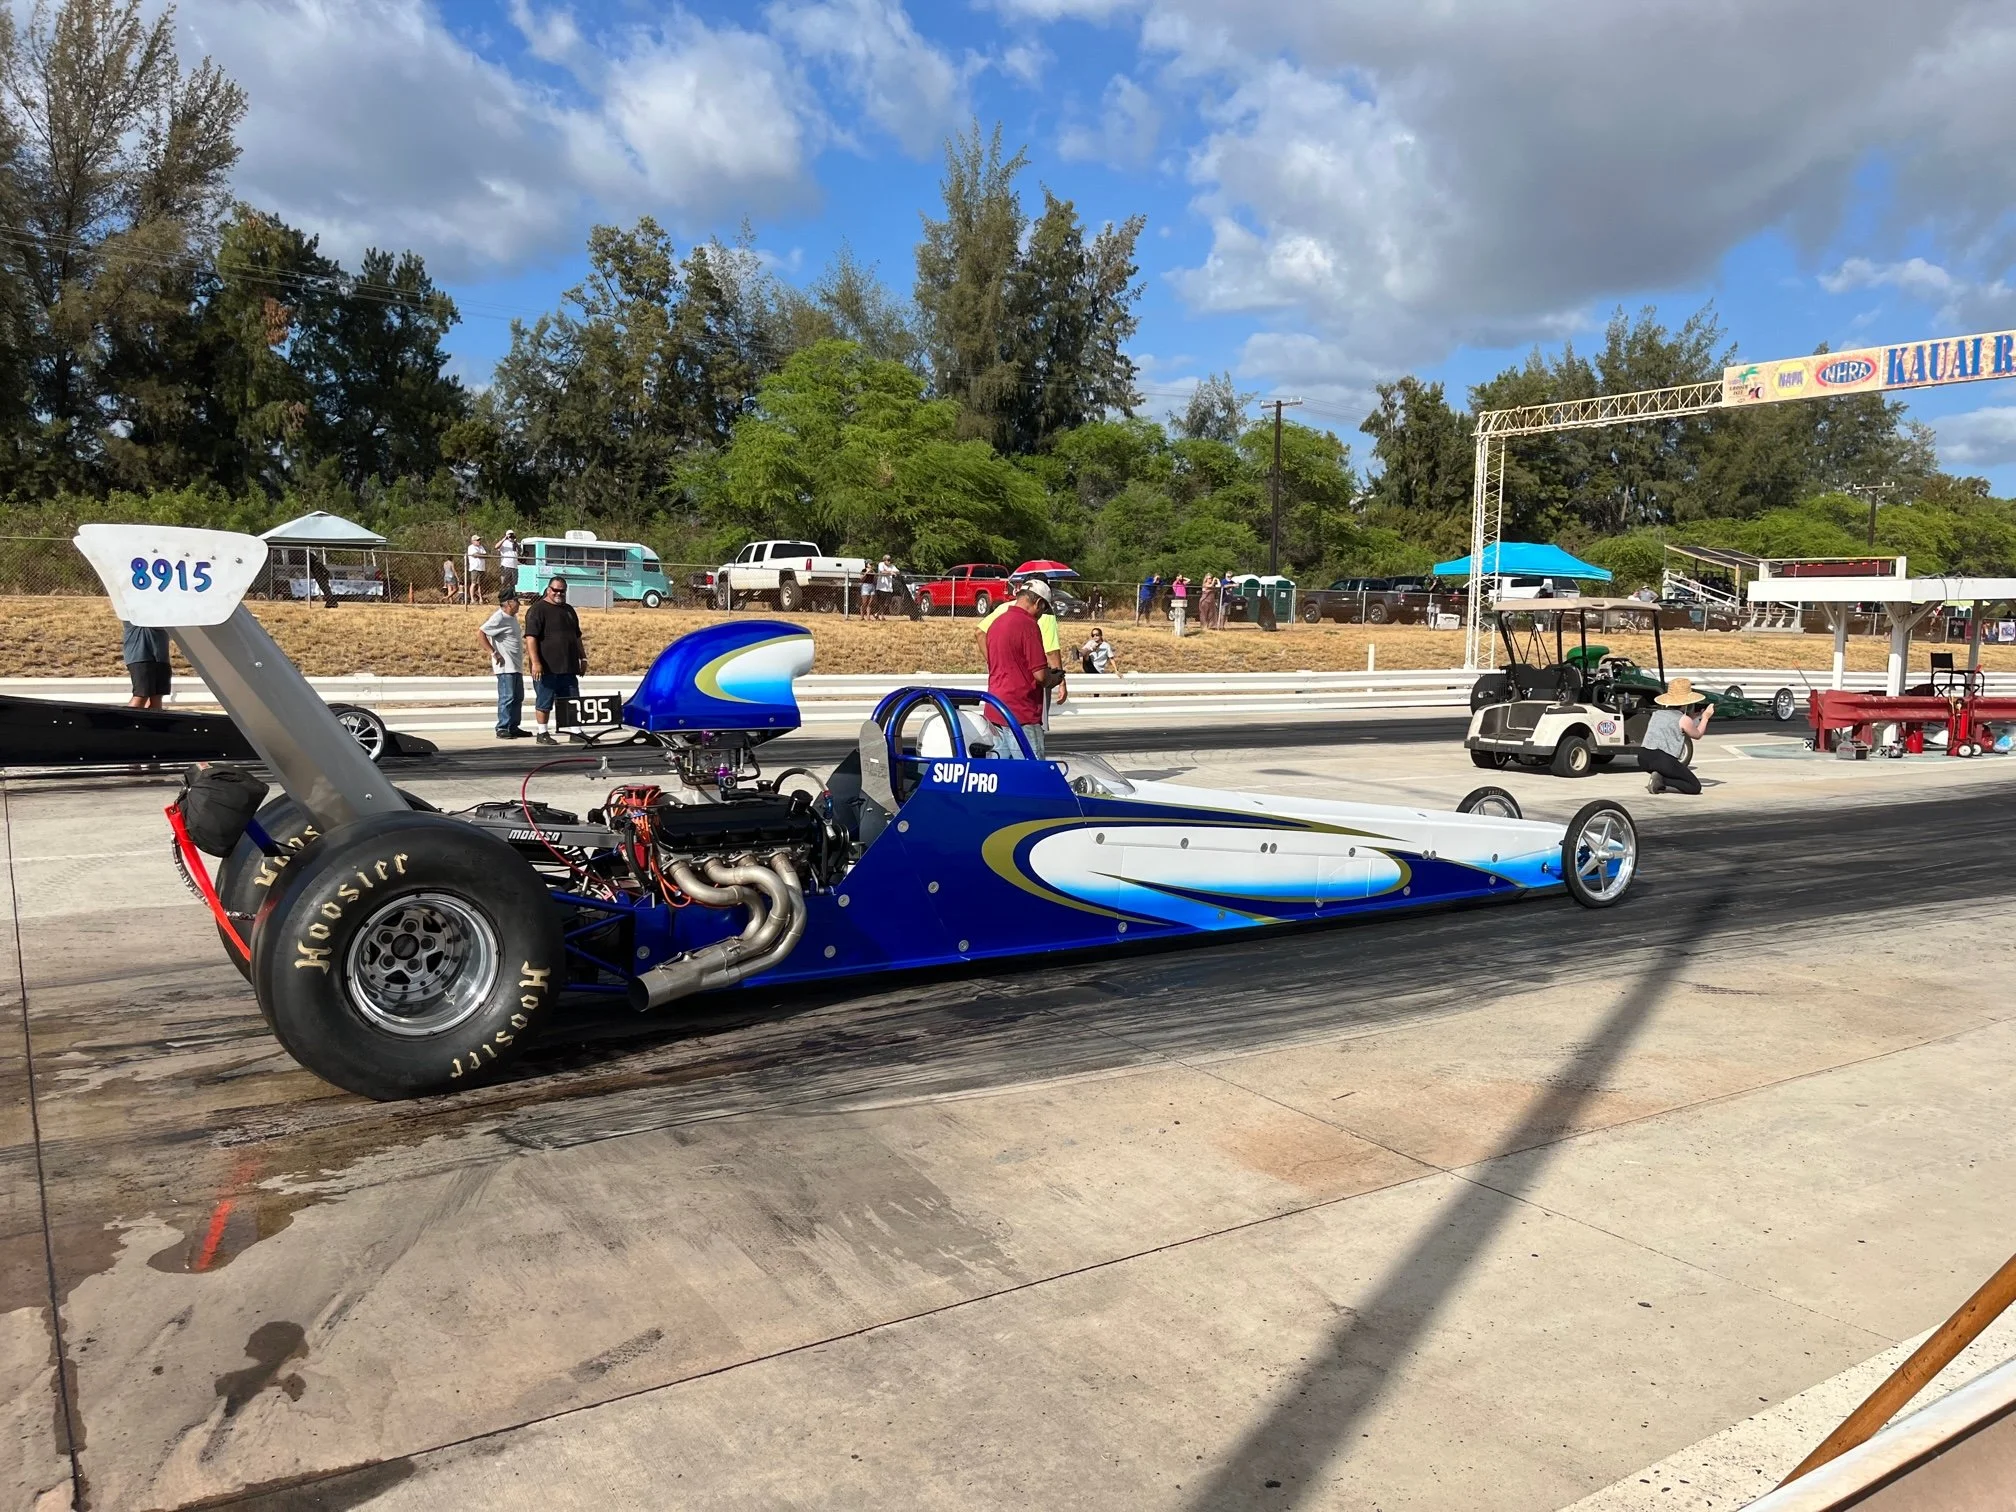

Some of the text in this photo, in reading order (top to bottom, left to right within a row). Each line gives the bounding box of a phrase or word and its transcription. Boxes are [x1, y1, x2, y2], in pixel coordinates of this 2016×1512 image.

[1825, 361, 1869, 383] NHRA
[1886, 337, 1983, 386] KAUAI
[1778, 370, 1804, 388] NAPA
[131, 557, 212, 592] 8915
[568, 698, 612, 724] 7.95
[932, 761, 998, 793] SUP/PRO
[508, 829, 561, 842] MOROSO
[294, 853, 409, 976] Hoosier
[450, 960, 551, 1078] Hoosier
